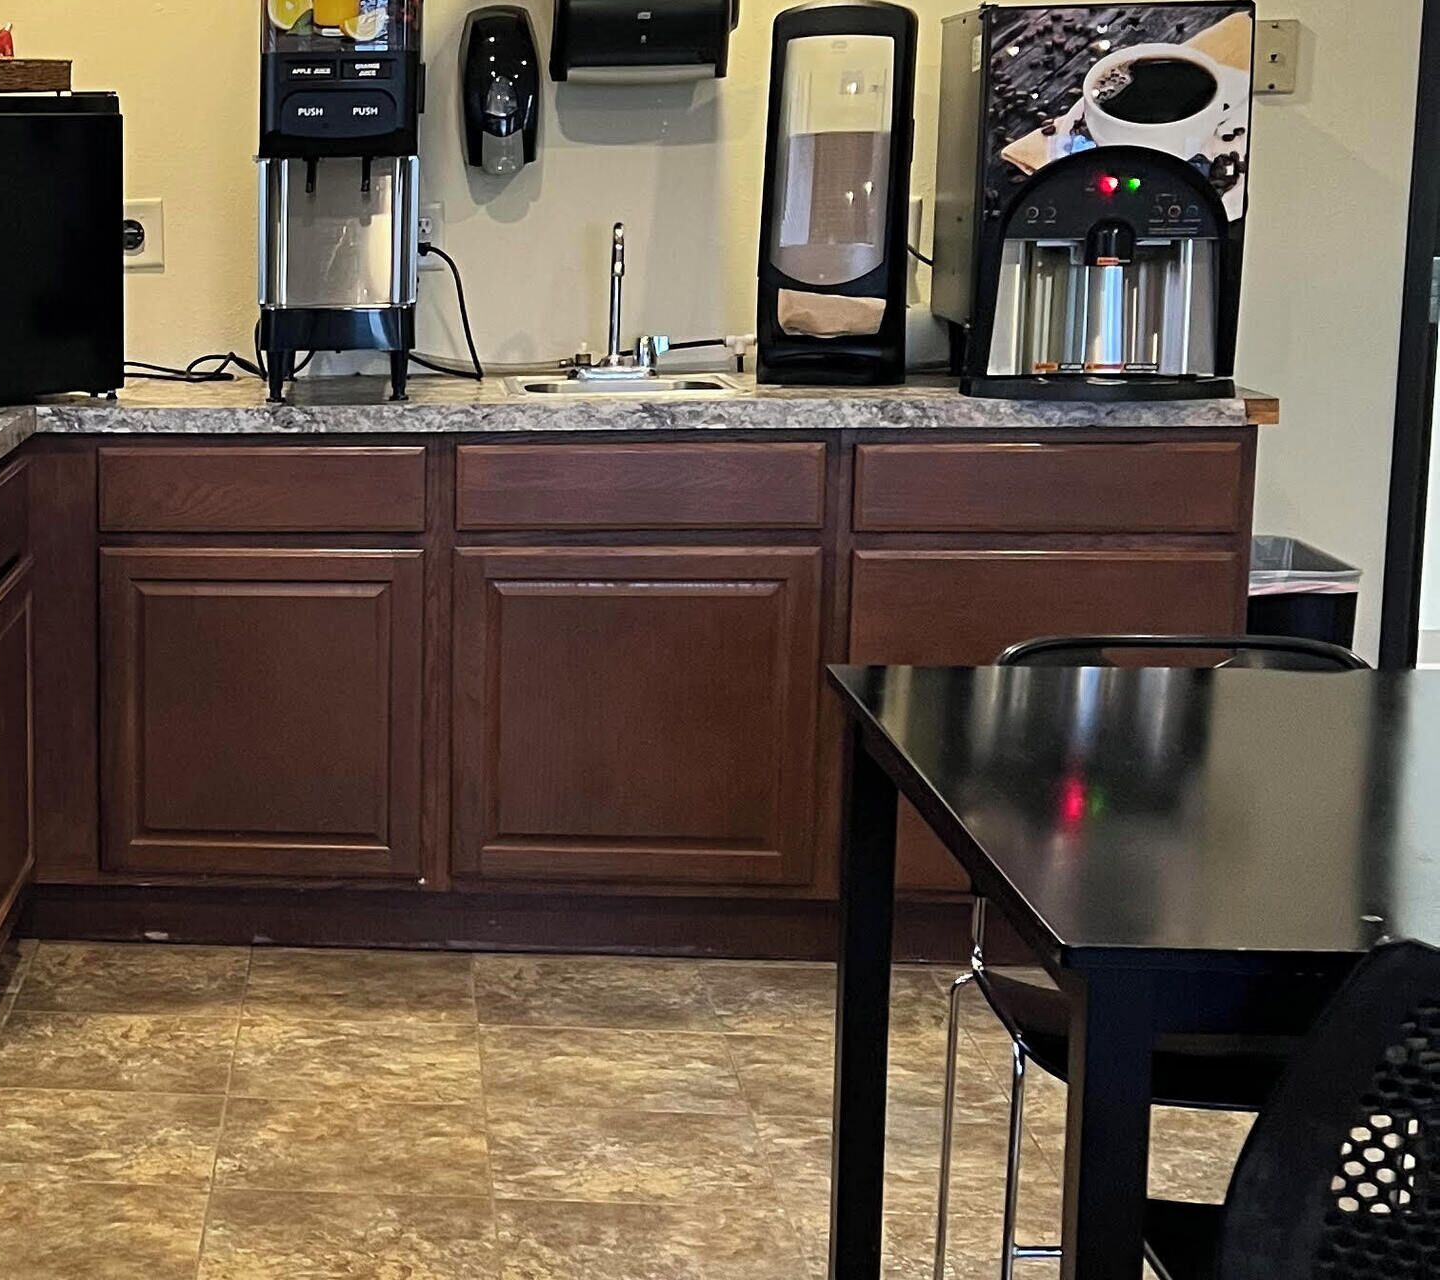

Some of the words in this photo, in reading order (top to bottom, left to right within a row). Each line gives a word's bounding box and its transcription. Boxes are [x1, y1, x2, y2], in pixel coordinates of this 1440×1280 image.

[354, 62, 380, 70] ORANGE
[291, 67, 312, 75] APPLE
[313, 67, 331, 75] JUICE
[297, 107, 324, 117] PUSH
[352, 106, 379, 116] PUSH
